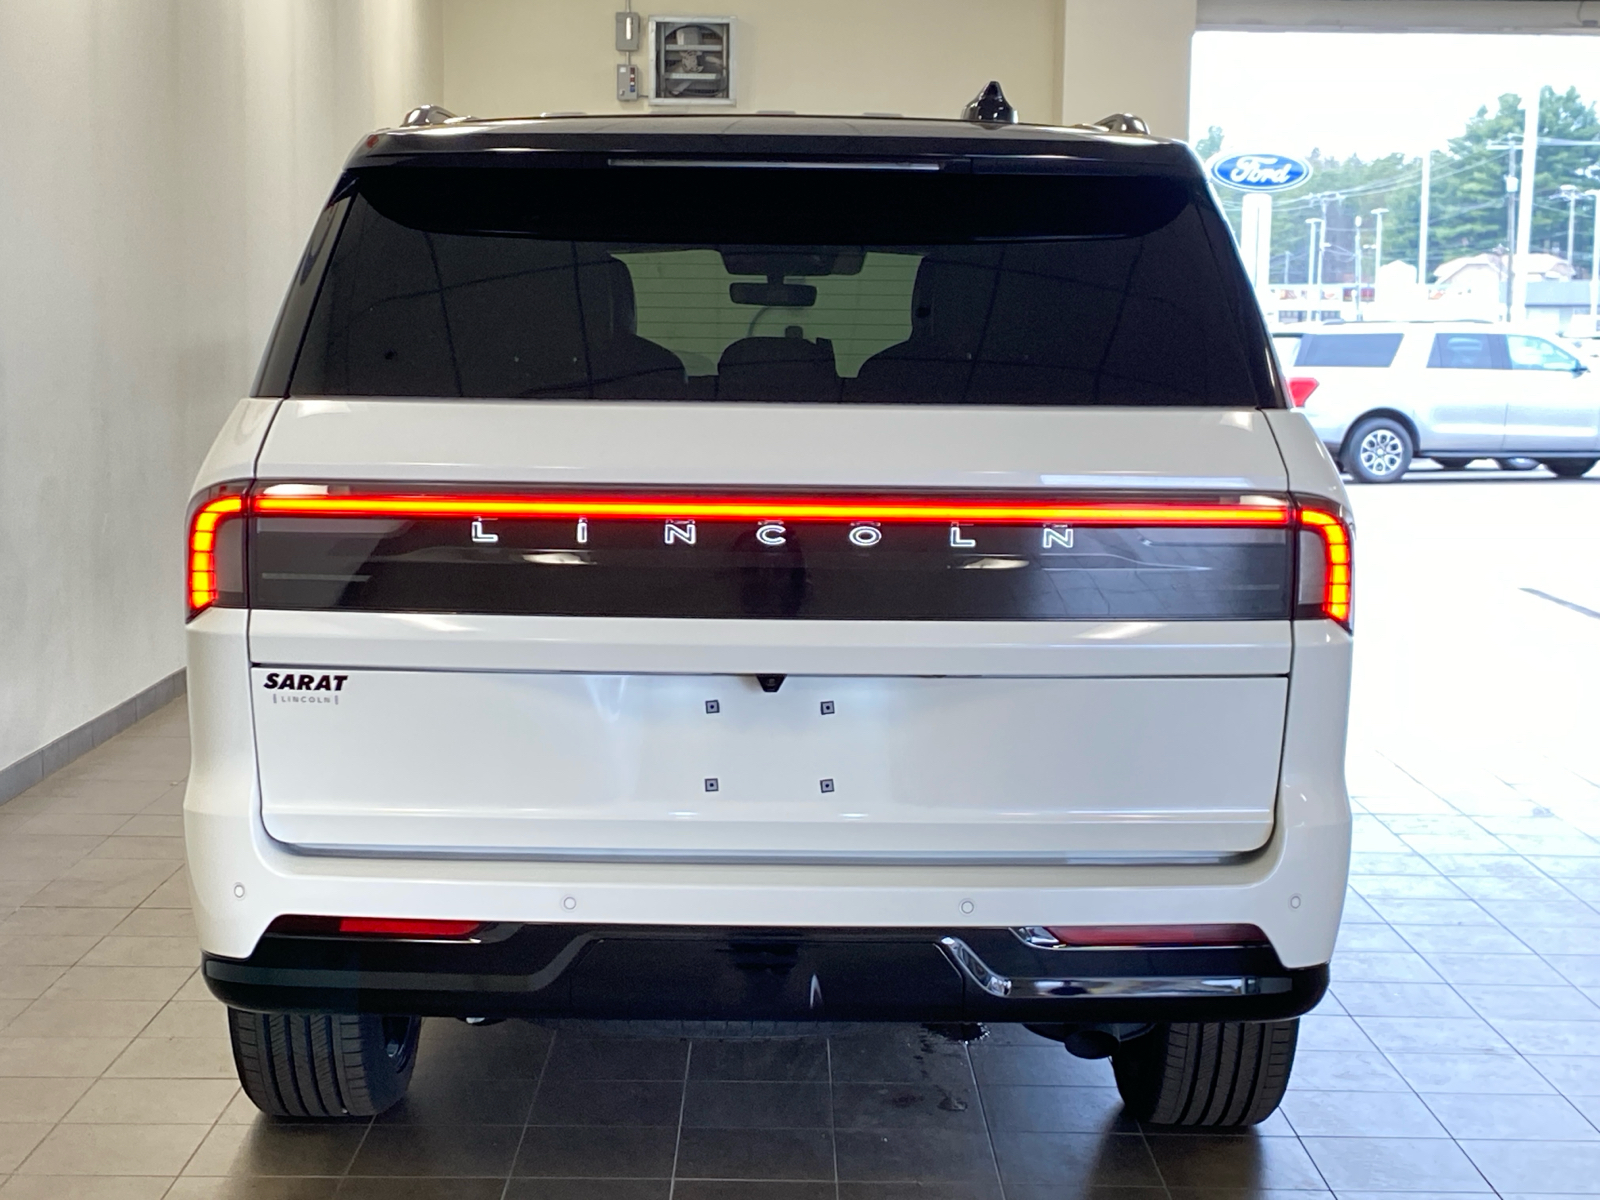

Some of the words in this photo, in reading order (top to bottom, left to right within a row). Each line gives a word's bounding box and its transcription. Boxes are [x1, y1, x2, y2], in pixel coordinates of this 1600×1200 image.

[1230, 156, 1292, 183] Ford
[471, 520, 1074, 548] LINCOLN
[263, 672, 349, 691] SARAT
[280, 695, 331, 704] LINCOLN
